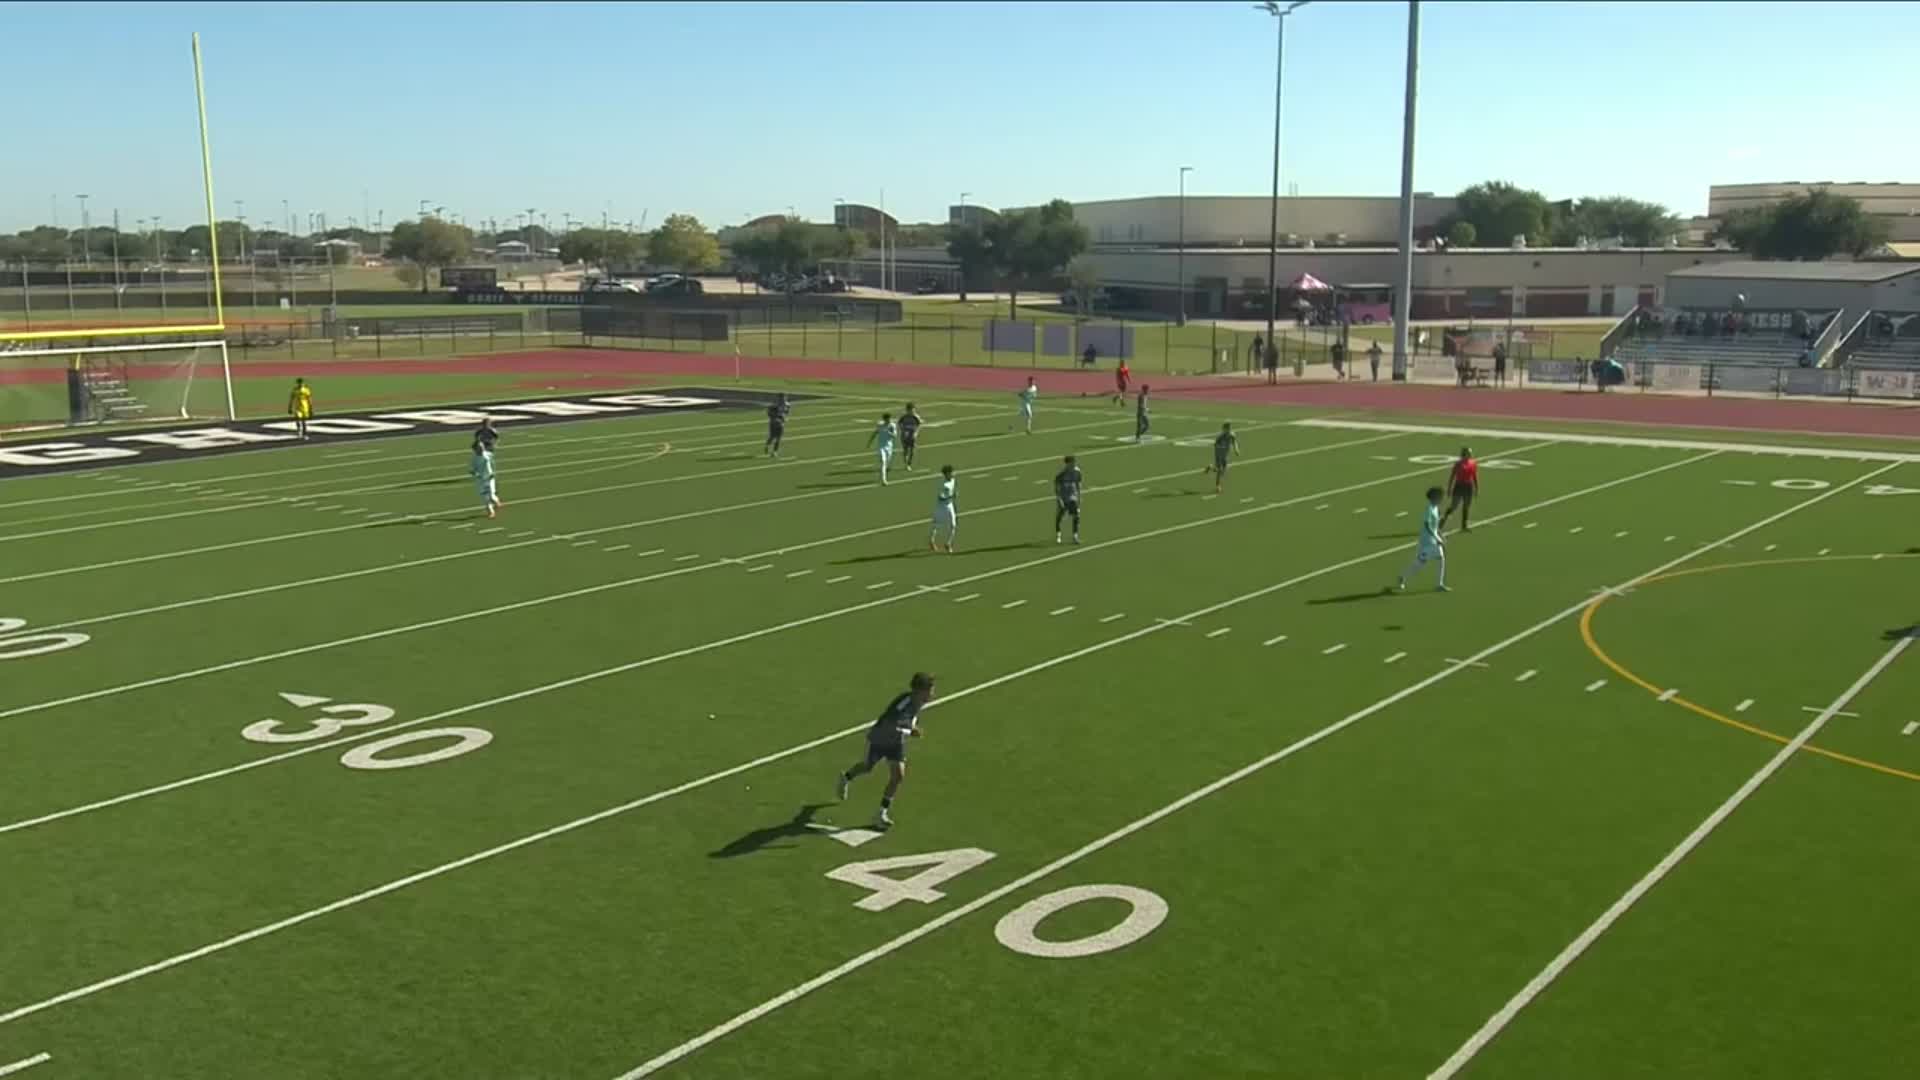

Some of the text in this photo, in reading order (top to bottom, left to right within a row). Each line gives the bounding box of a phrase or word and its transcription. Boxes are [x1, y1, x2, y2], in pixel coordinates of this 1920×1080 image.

[0, 617, 91, 659] 0
[242, 703, 493, 770] 30
[824, 847, 1170, 959] 40
